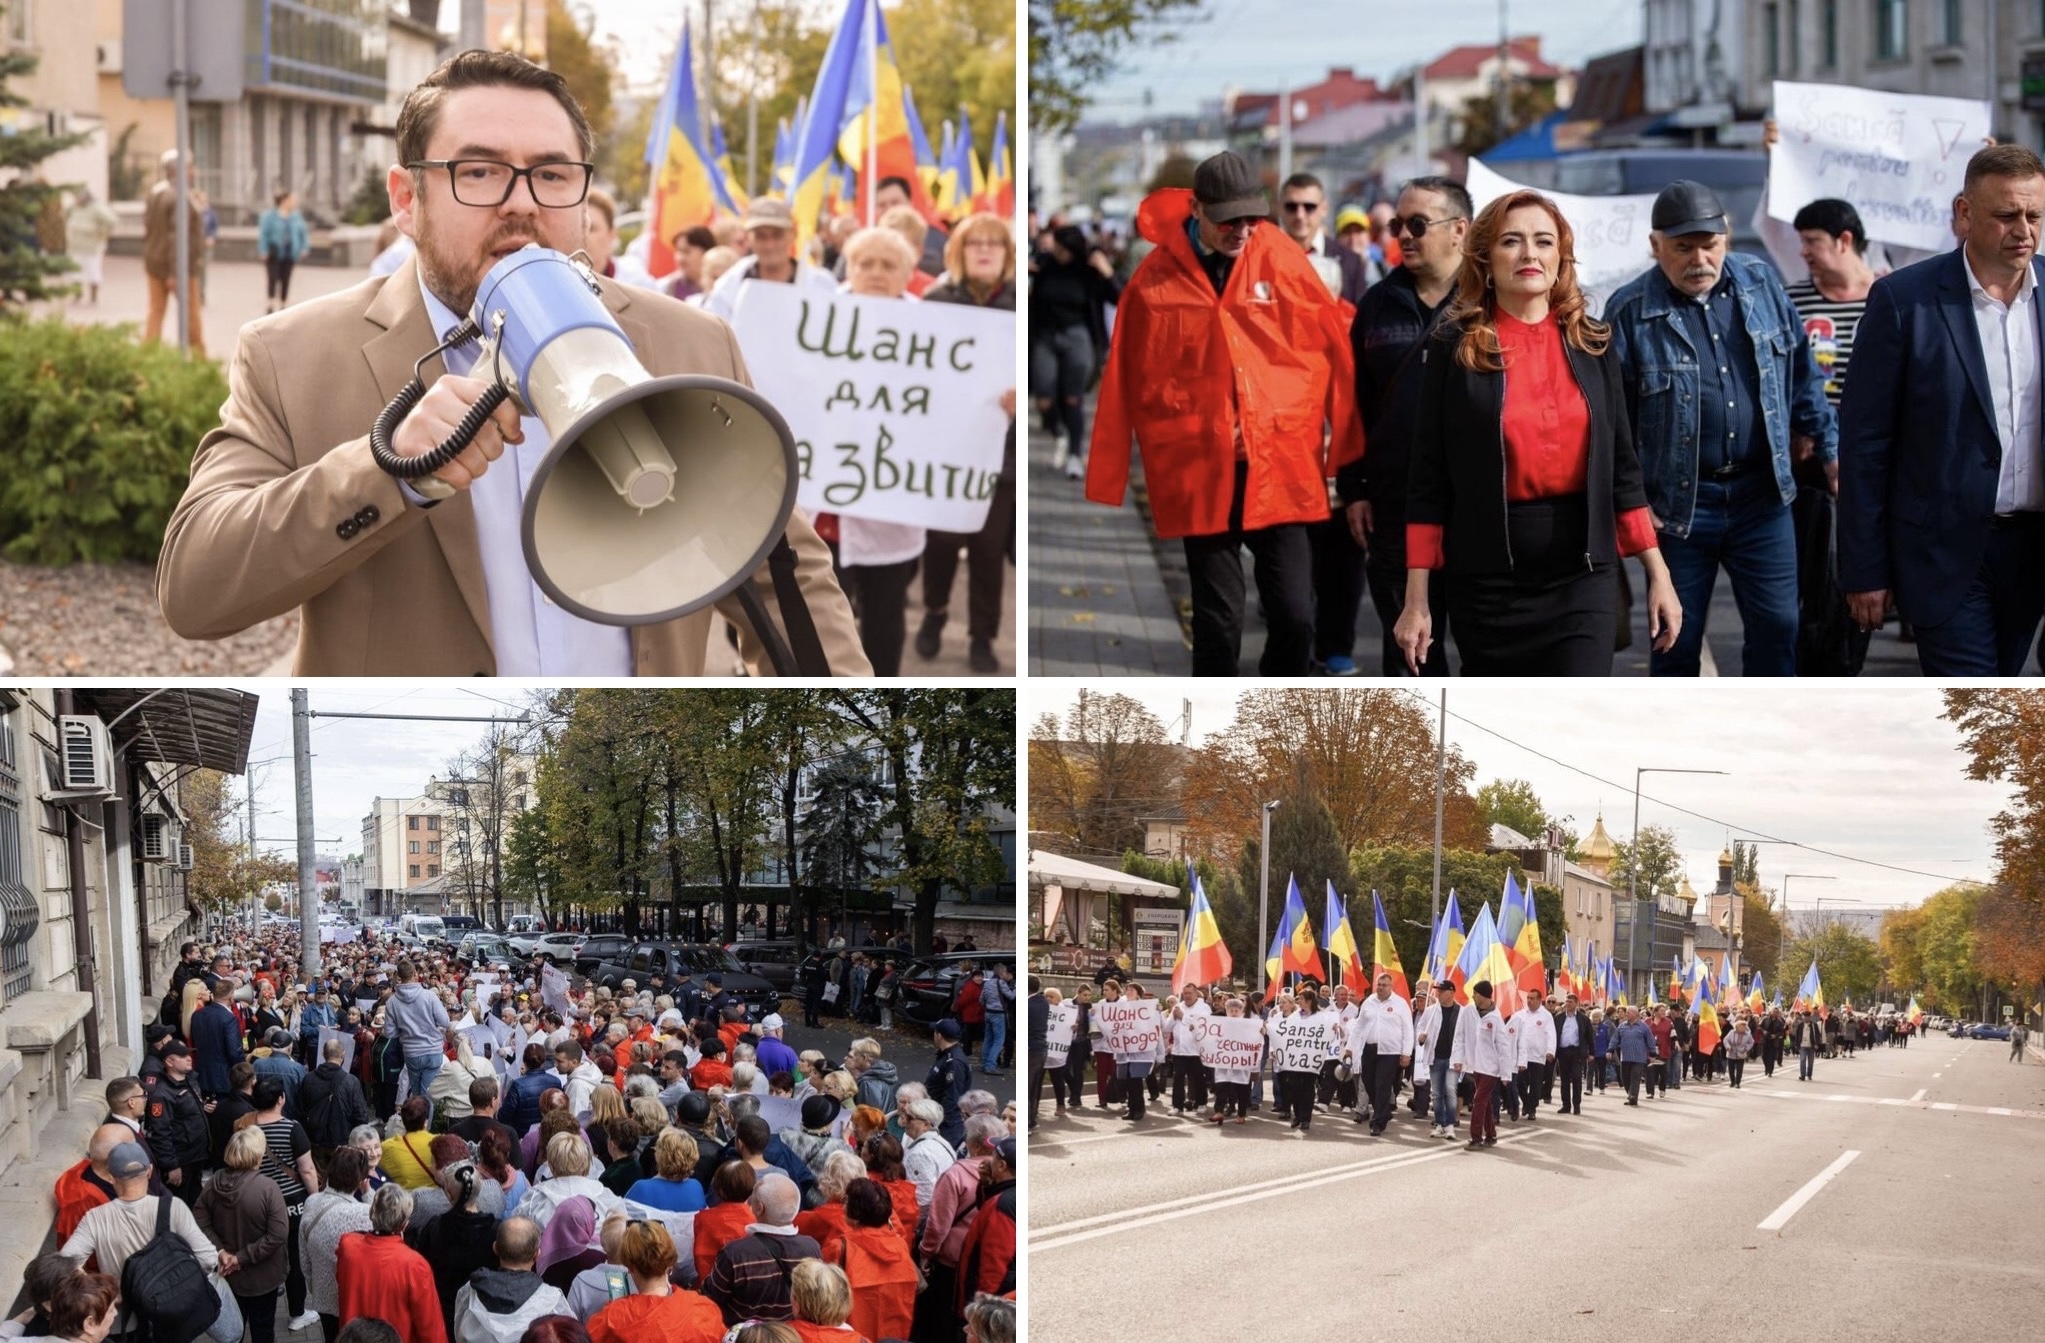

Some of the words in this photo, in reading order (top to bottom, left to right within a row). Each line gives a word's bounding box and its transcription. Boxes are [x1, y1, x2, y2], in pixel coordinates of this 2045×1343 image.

[796, 299, 976, 372] Шанс
[825, 380, 930, 415] для
[796, 423, 1001, 507] азвития
[1047, 1010, 1066, 1023] анс
[1101, 1006, 1151, 1021] Шанс
[1107, 1025, 1160, 1052] арода!
[1112, 1022, 1134, 1034] для
[1195, 1016, 1223, 1042] За
[1217, 1038, 1262, 1052] честные
